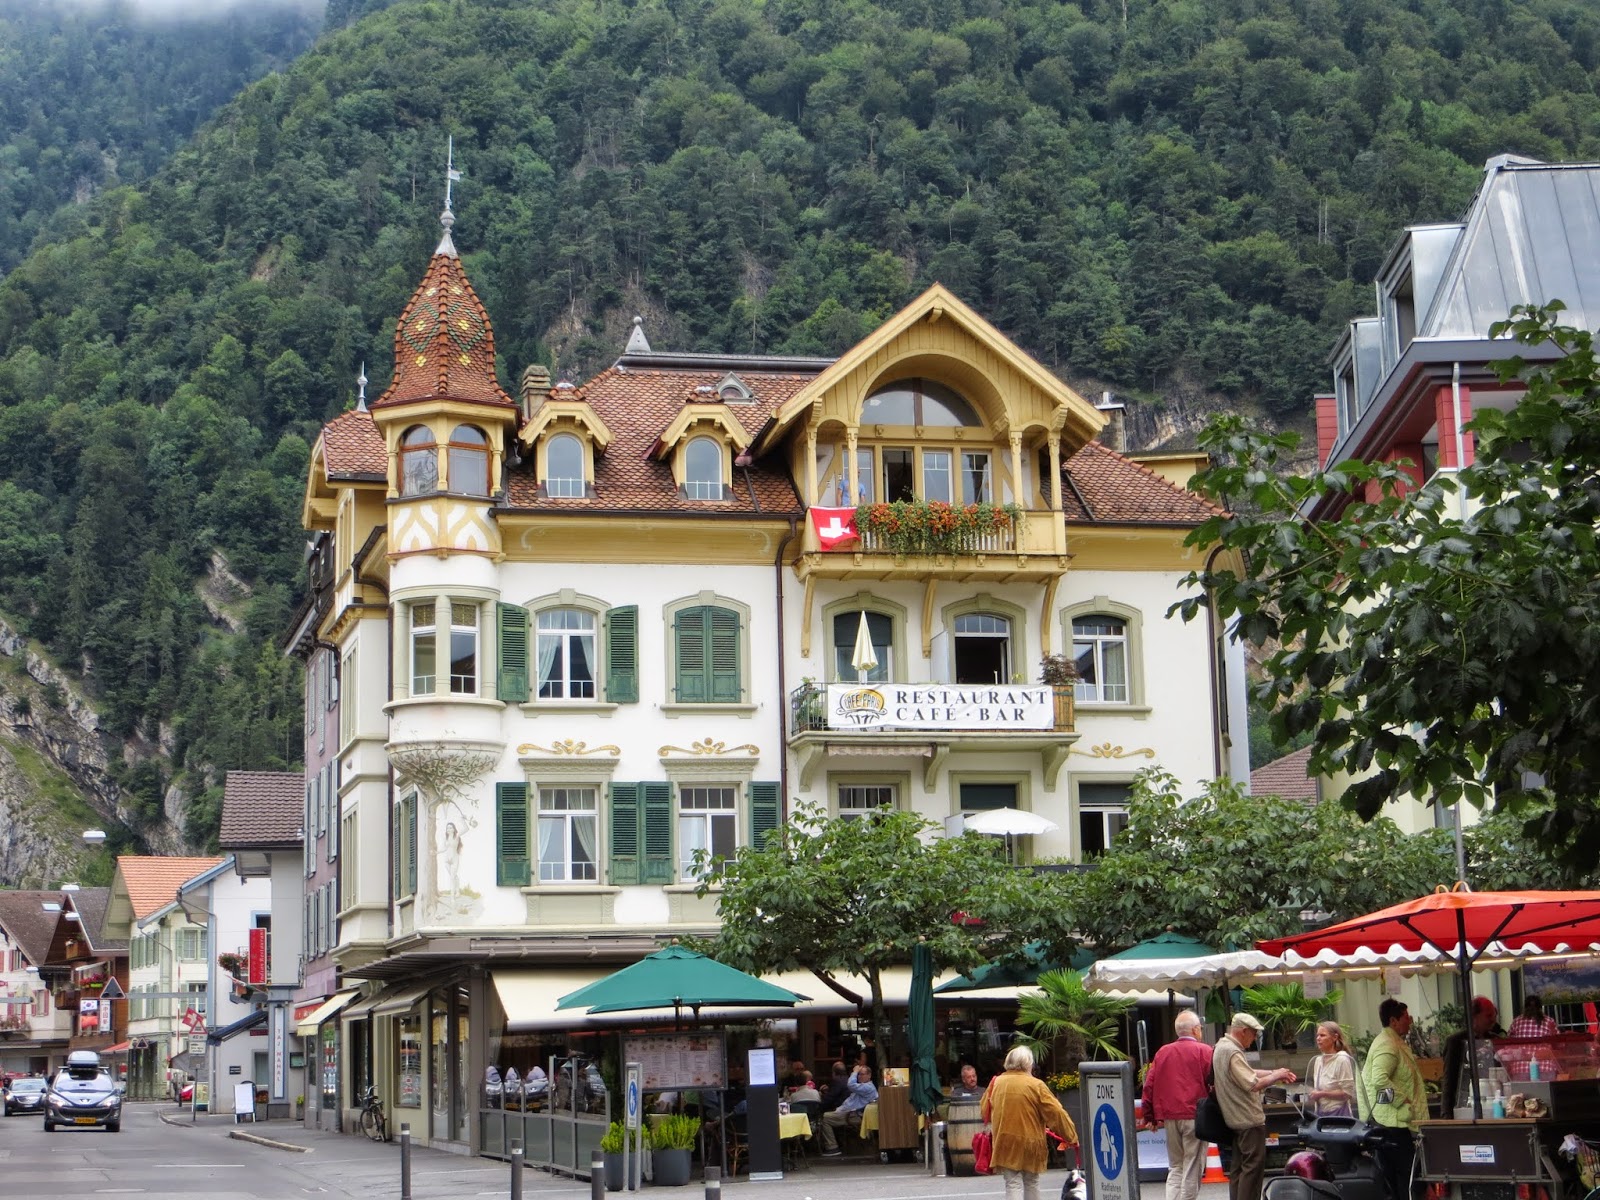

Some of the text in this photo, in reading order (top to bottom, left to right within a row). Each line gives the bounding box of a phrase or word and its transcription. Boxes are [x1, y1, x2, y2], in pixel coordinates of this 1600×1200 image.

[896, 690, 1048, 705] RESTAURANT
[896, 704, 1025, 721] CAFÉ BAR
[1096, 1085, 1115, 1099] ZONE
[1101, 1182, 1122, 1192] Radfahren
